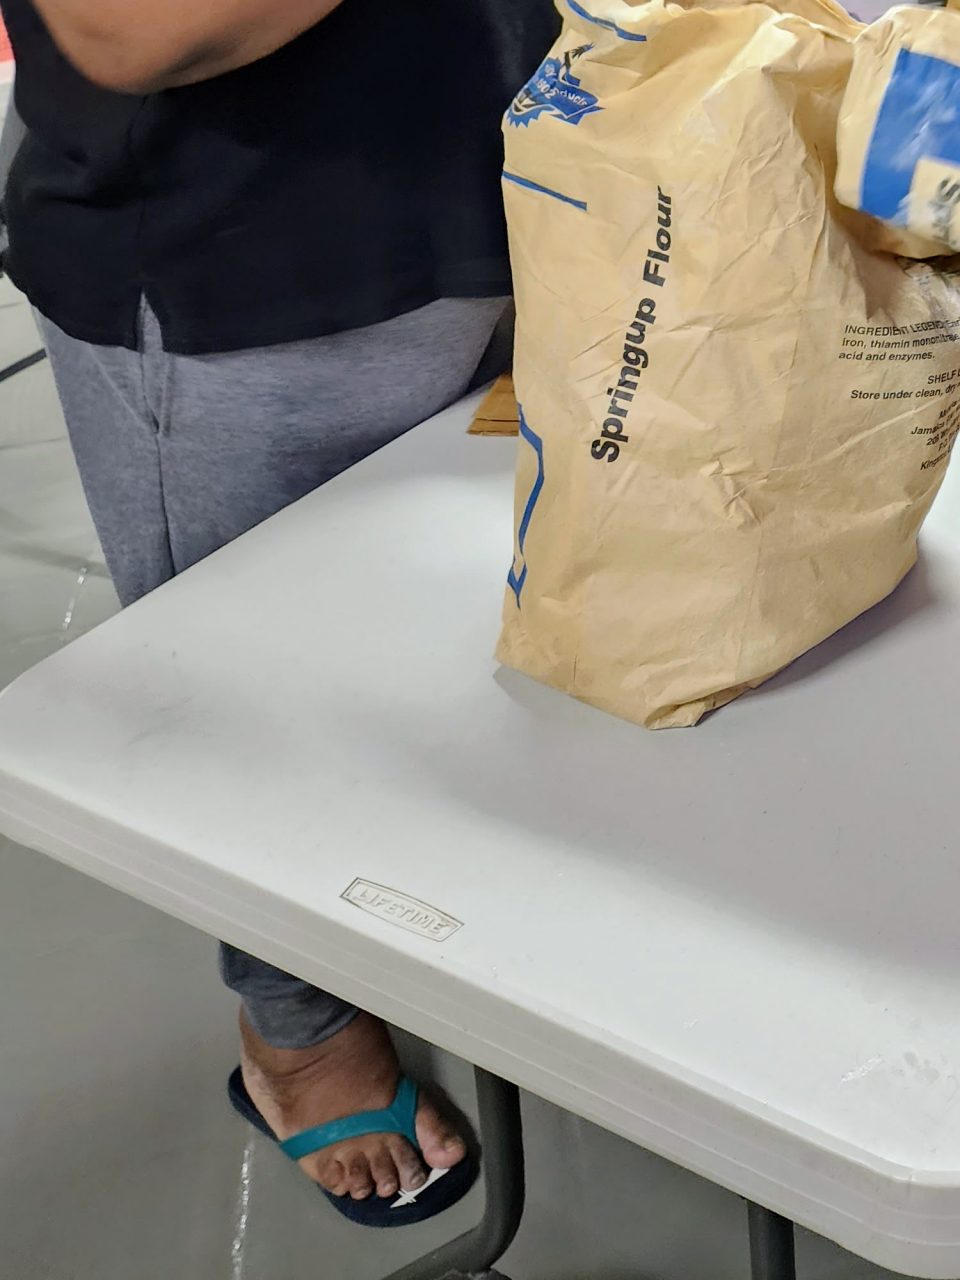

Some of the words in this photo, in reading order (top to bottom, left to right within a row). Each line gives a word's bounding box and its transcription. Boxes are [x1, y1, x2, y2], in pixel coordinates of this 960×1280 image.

[590, 297, 657, 463] Springup
[642, 184, 672, 287] Flour
[844, 324, 909, 337] INGREDIENT
[870, 338, 910, 350] thiamin
[838, 350, 864, 361] acid
[865, 351, 887, 361] and
[888, 350, 936, 362] enzymes.
[927, 369, 957, 385] SHELF
[850, 389, 880, 400] Store
[883, 389, 912, 400] under
[915, 388, 943, 400] clean,
[352, 889, 450, 935] LIFETIME
